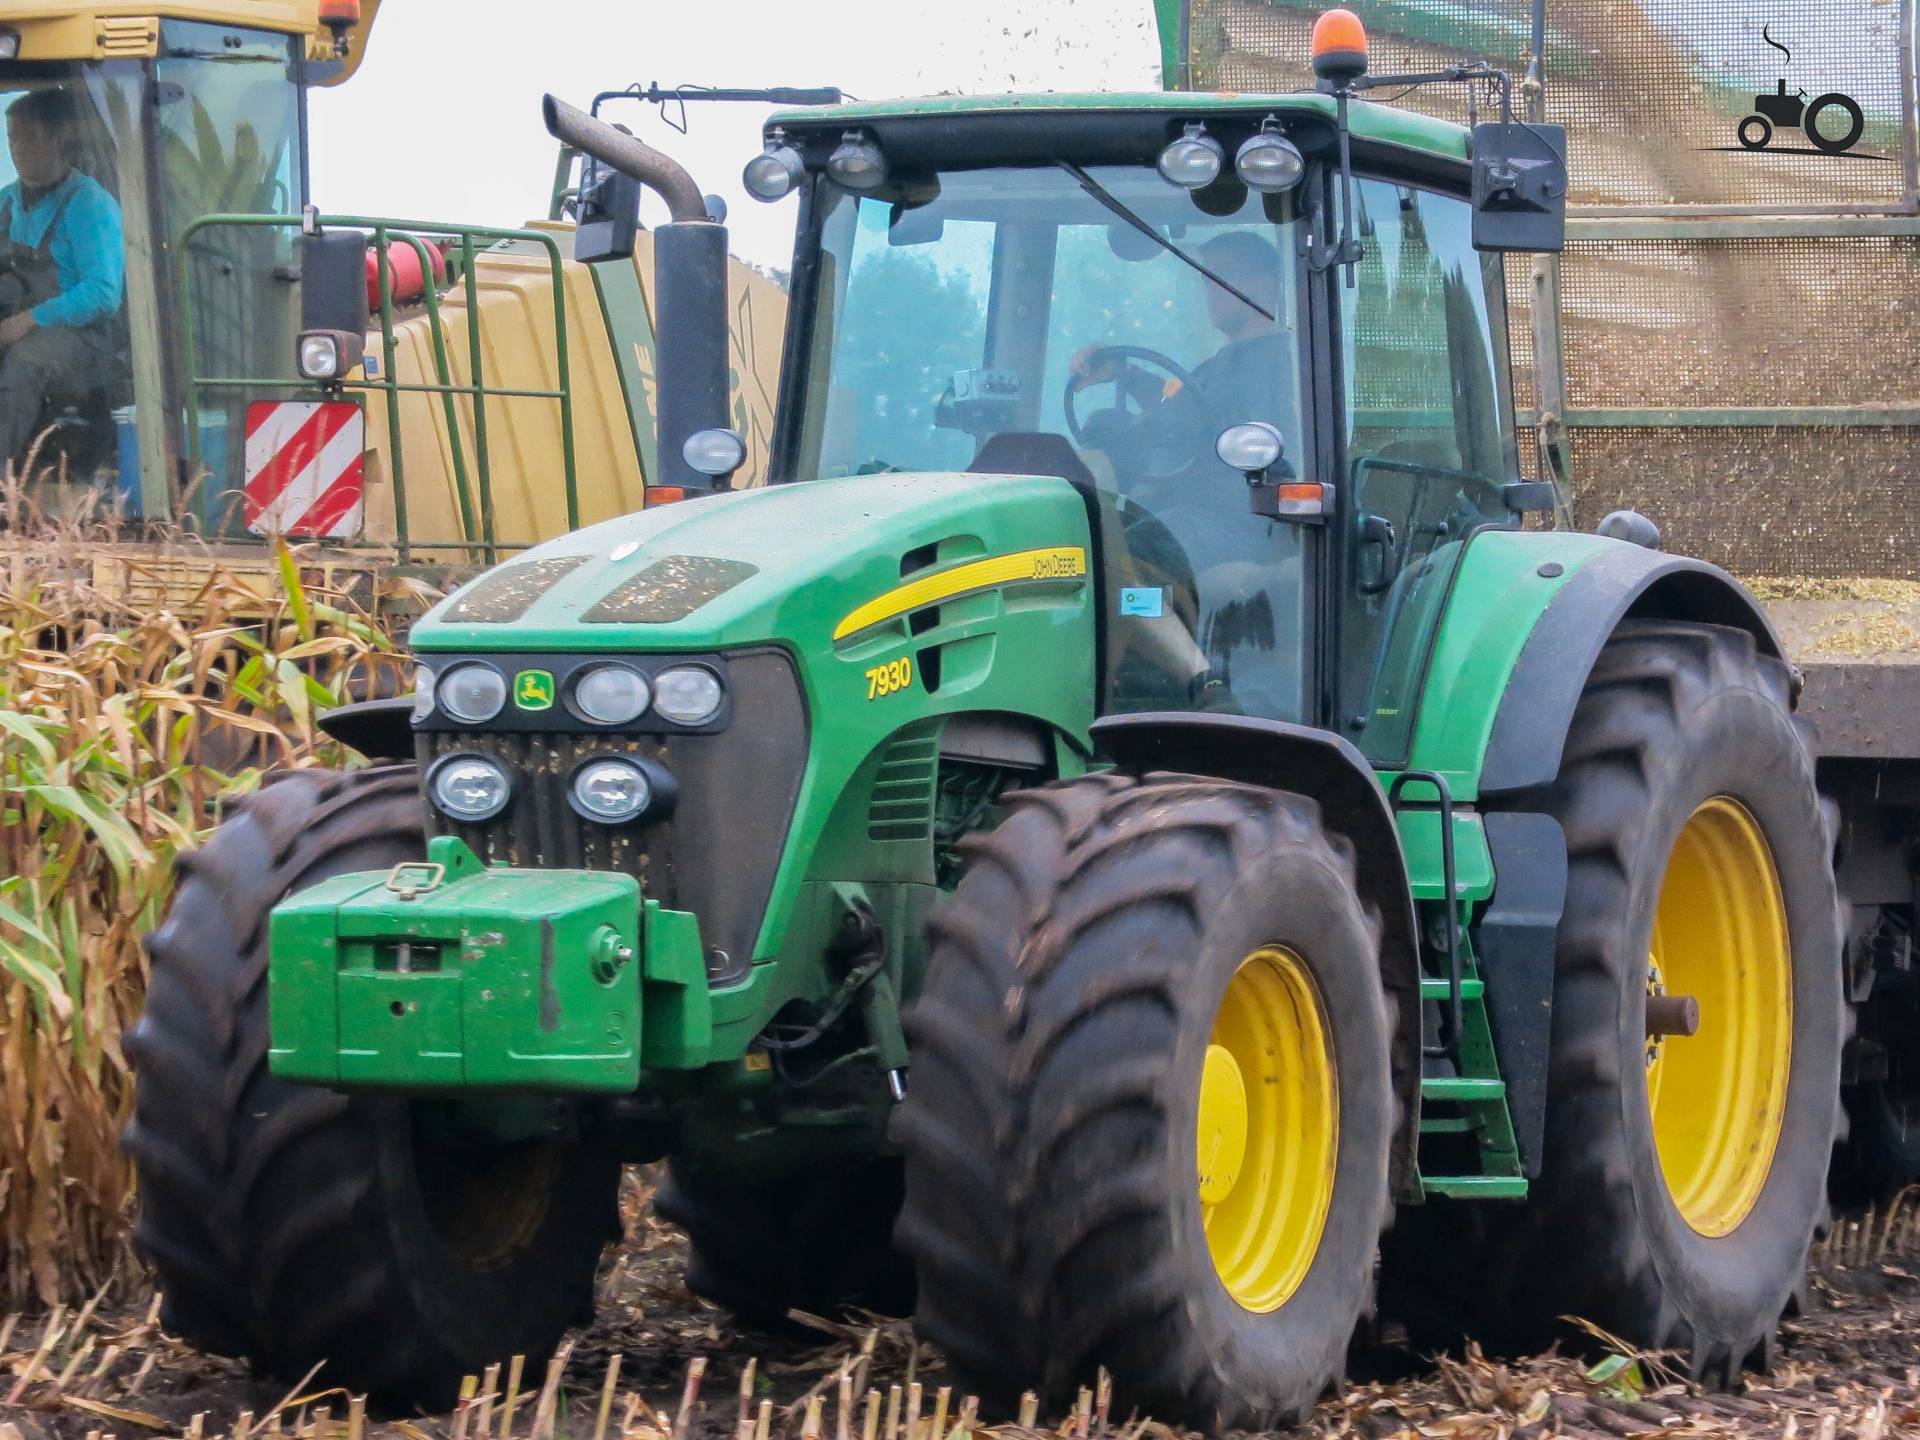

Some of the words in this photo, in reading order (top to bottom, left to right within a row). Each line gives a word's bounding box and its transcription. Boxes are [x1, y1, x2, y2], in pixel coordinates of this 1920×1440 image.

[1032, 557, 1053, 577] JOHN
[1053, 554, 1077, 575] DEERE
[864, 656, 912, 701] 7930
